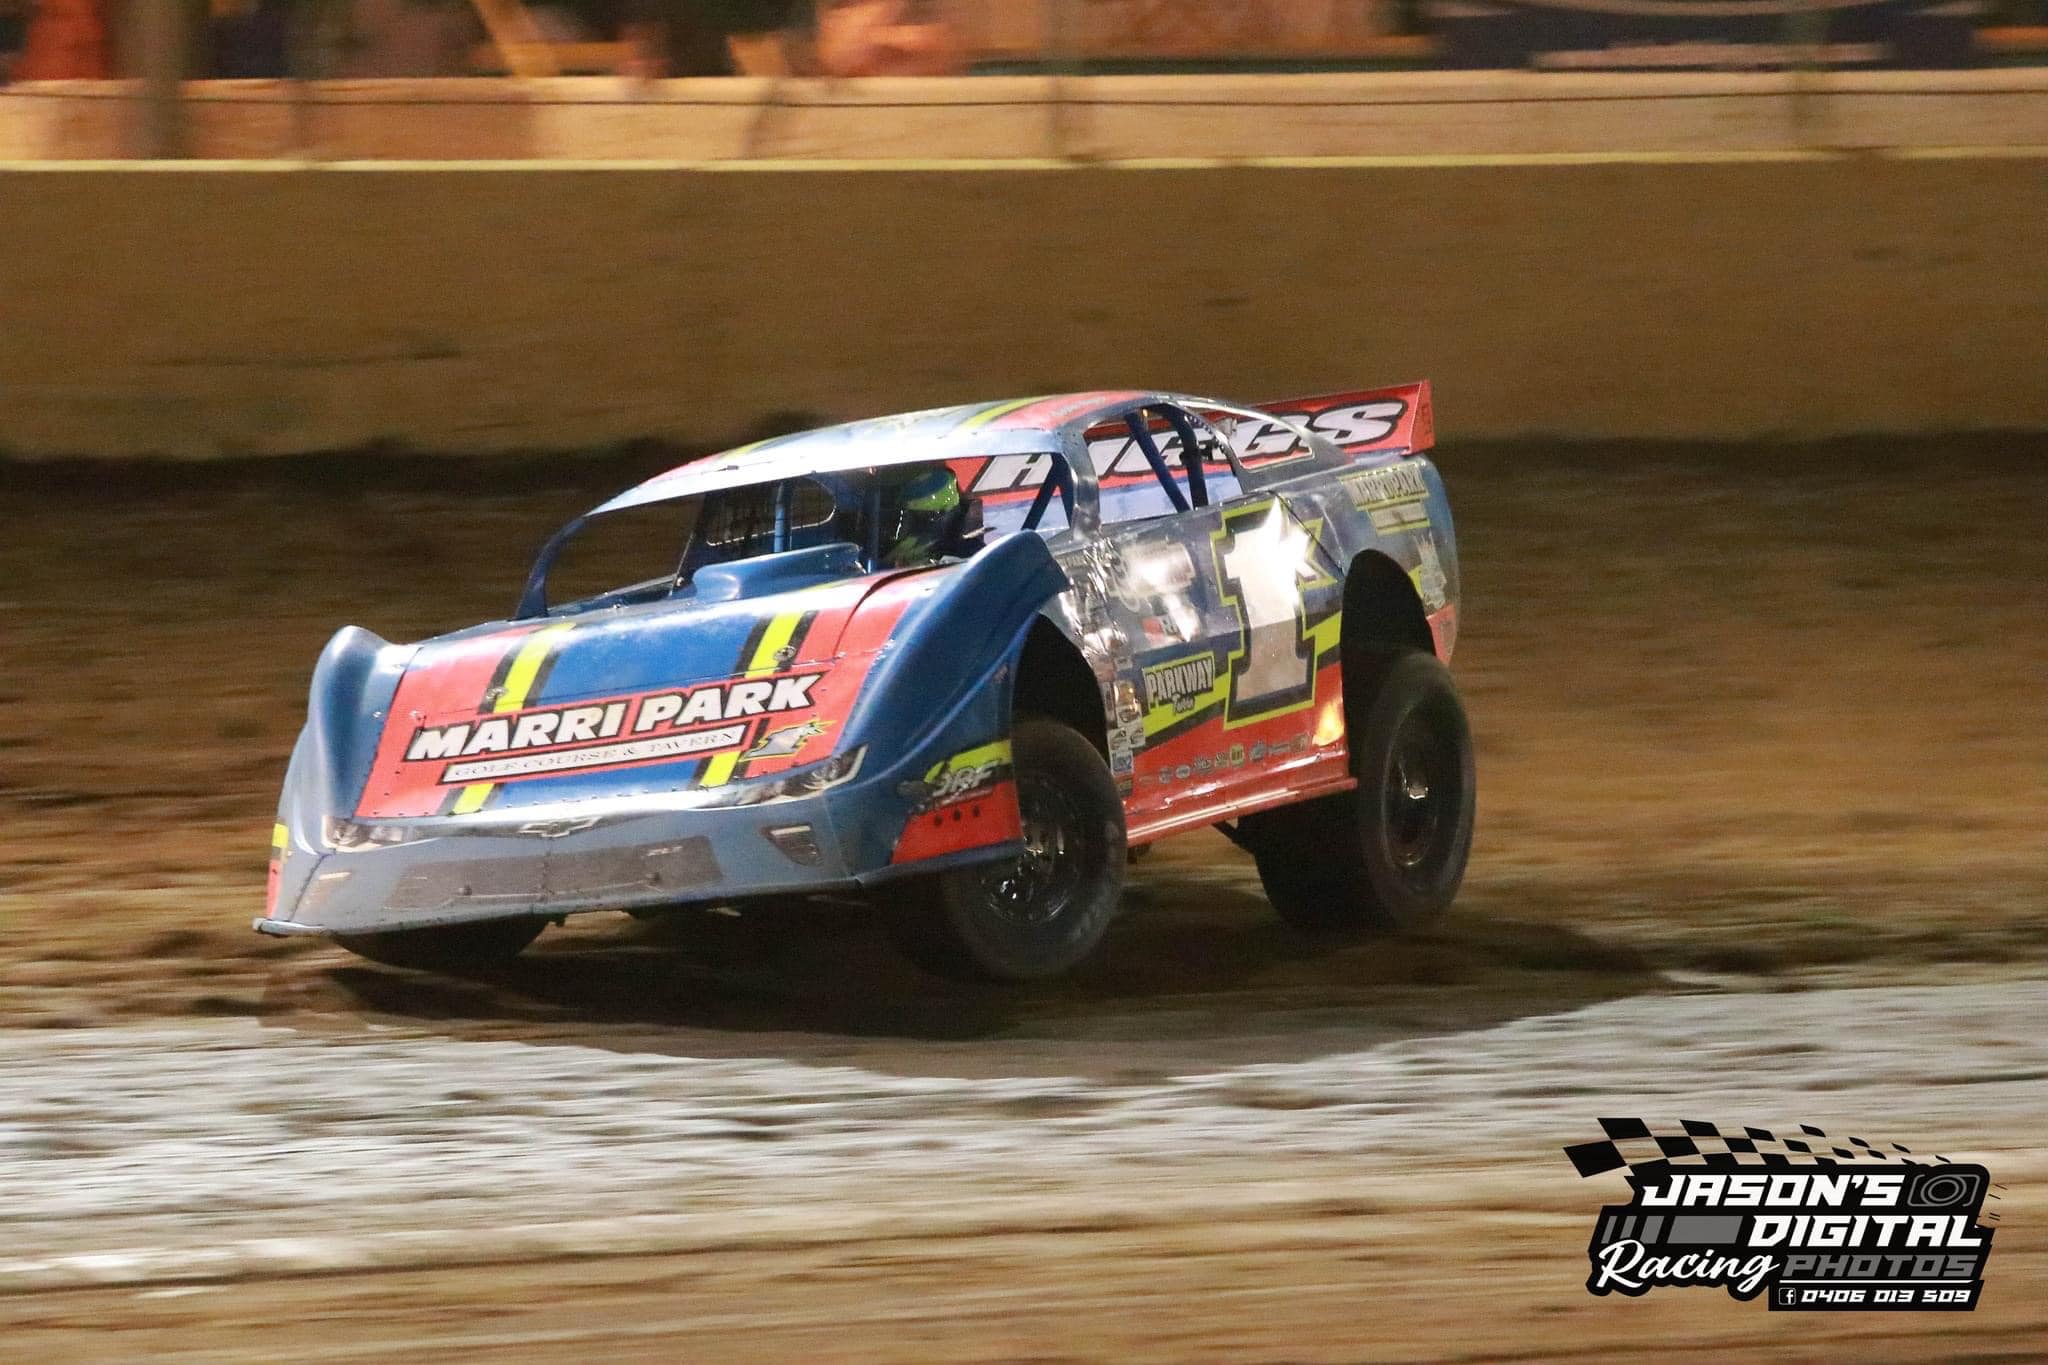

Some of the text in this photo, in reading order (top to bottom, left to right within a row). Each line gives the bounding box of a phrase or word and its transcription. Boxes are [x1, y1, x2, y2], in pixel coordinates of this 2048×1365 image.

[1222, 498, 1330, 702] 1
[1146, 659, 1213, 704] PARKWAY
[406, 674, 822, 762] MARRI PARK
[522, 751, 618, 771] COURSE
